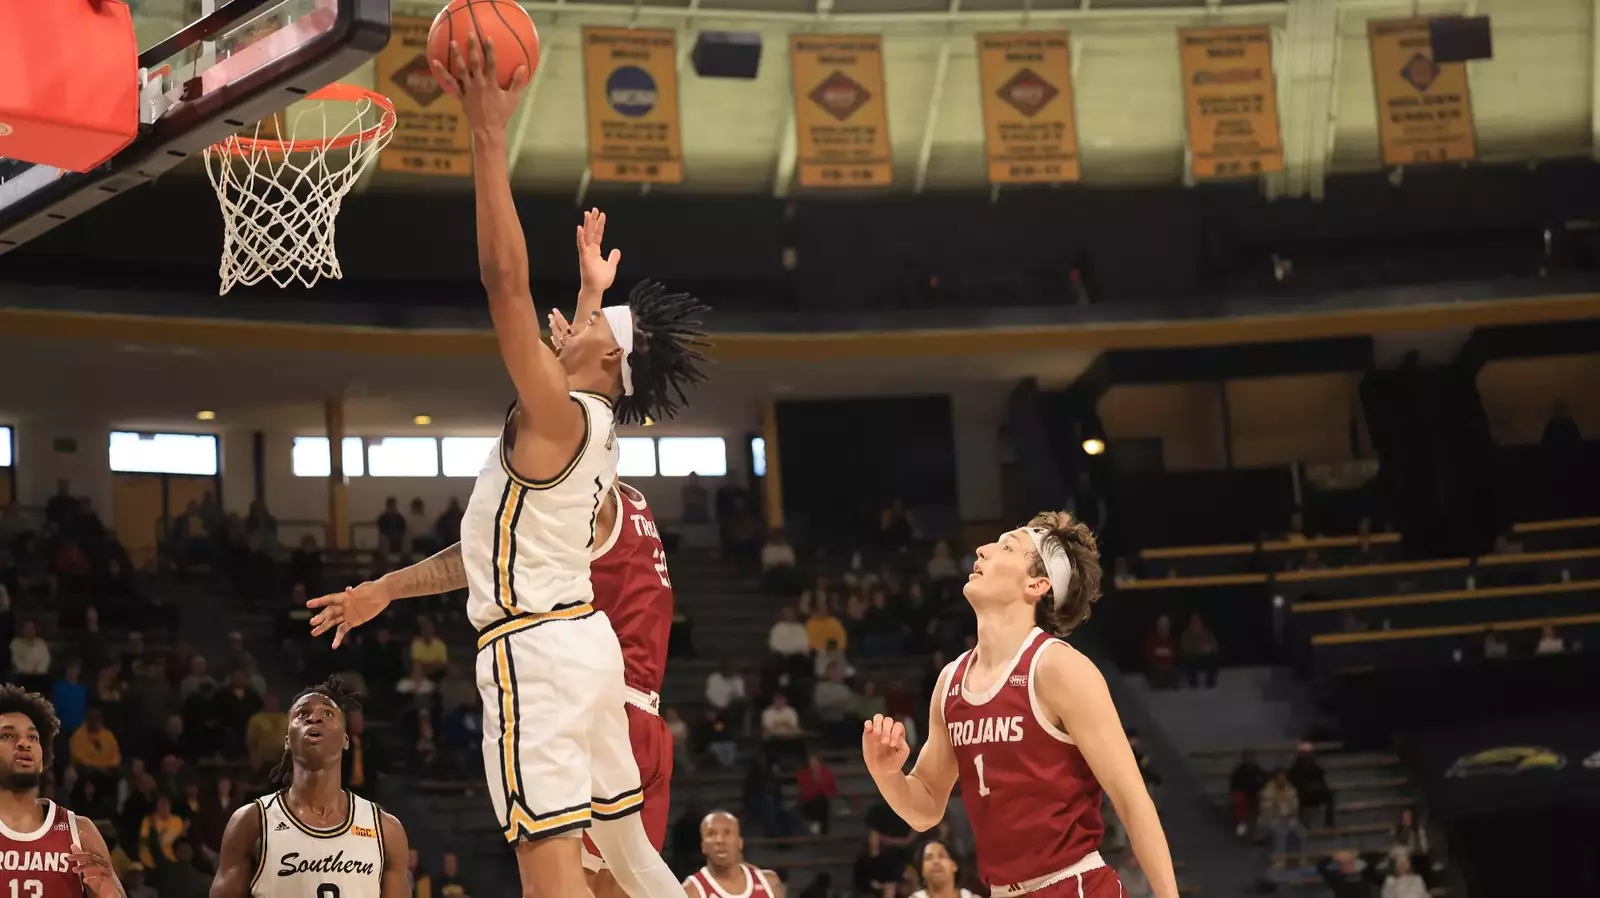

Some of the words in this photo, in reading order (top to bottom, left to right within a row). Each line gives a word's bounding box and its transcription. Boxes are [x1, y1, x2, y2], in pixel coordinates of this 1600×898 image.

[947, 716, 1024, 747] TROJANS
[973, 753, 990, 797] 1
[0, 850, 71, 873] OJANS
[277, 850, 374, 877] Southern
